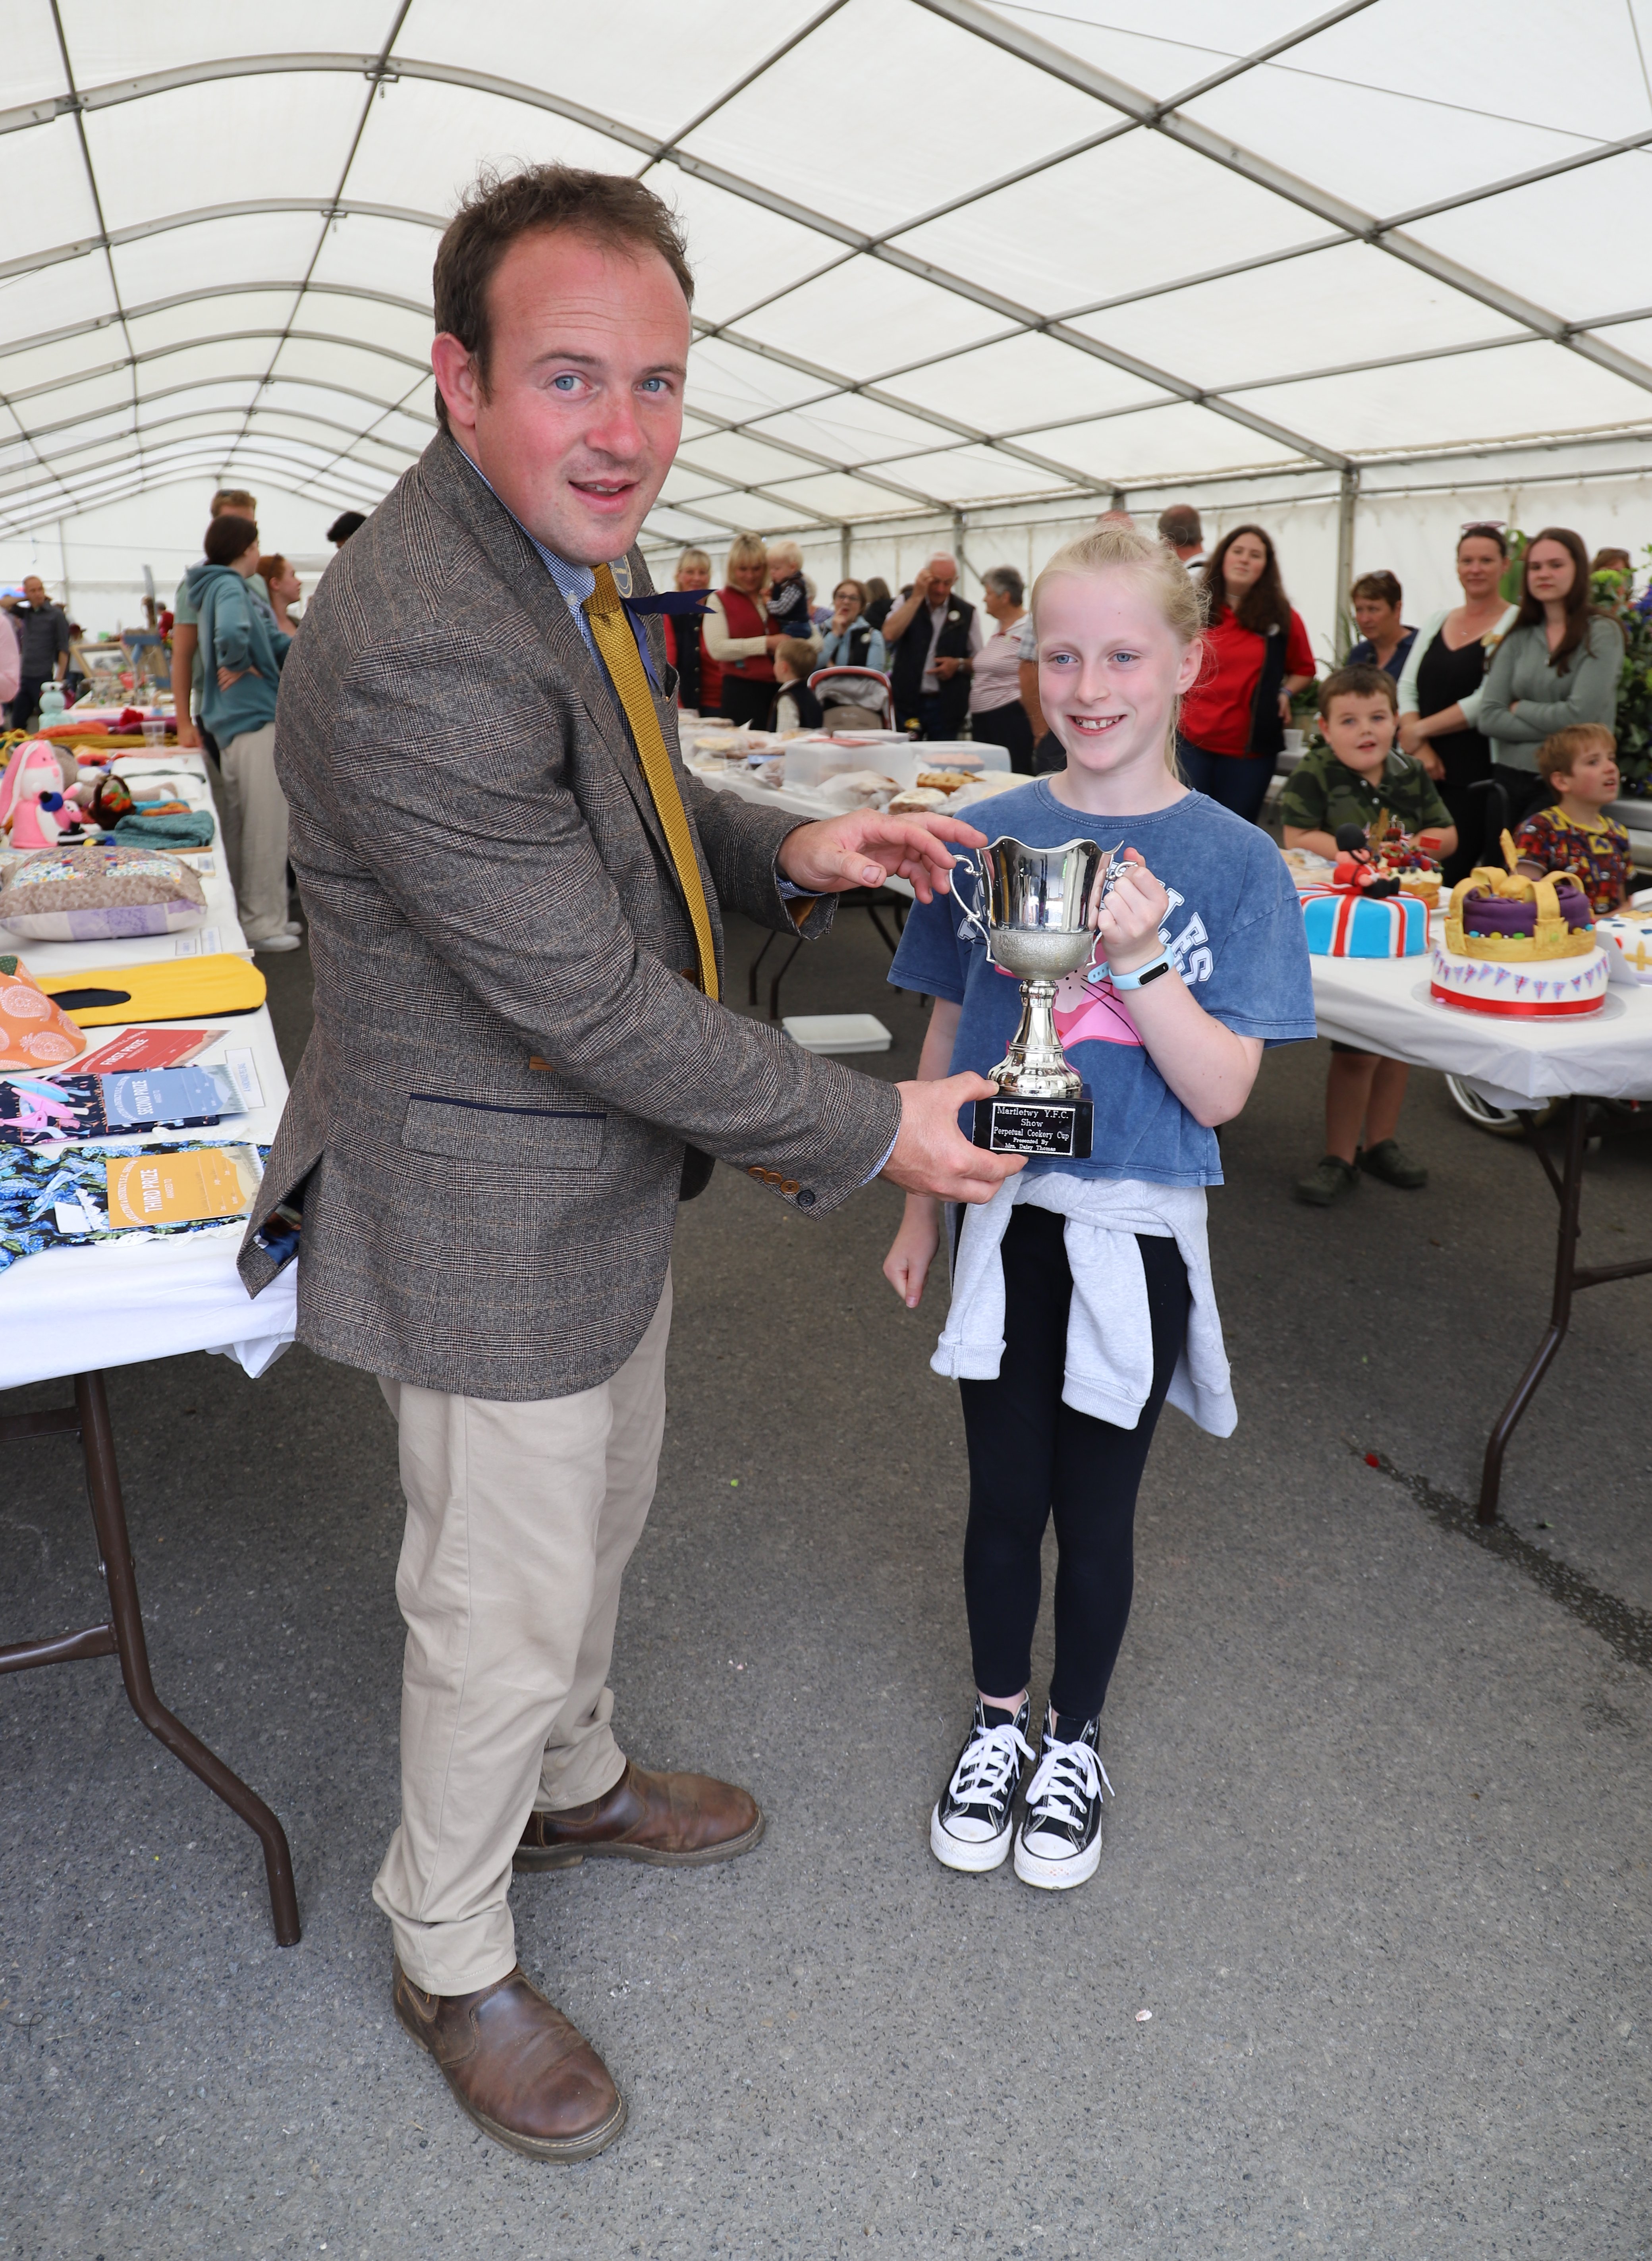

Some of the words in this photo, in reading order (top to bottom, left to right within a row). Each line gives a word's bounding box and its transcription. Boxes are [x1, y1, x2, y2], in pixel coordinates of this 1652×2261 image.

[100, 1052, 128, 1065] FIRST
[120, 1039, 149, 1052] PRIZE
[131, 1080, 149, 1096] PRIZE
[135, 1096, 153, 1115] SECOND
[997, 1106, 1039, 1118] Martletwy
[1044, 1110, 1069, 1119] Y.F.C.
[1021, 1118, 1044, 1127] Show
[994, 1126, 1023, 1136] Perpetual
[1027, 1129, 1053, 1139] Cookery
[1057, 1131, 1069, 1141] Cup
[122, 1160, 138, 1173] SHOW
[140, 1168, 160, 1189] PRIZE
[118, 1183, 127, 1200] DISTRICT
[164, 1183, 175, 1199] AWARDED
[143, 1189, 163, 1213] THIRD
[120, 1203, 147, 1224] MARTLETWY
